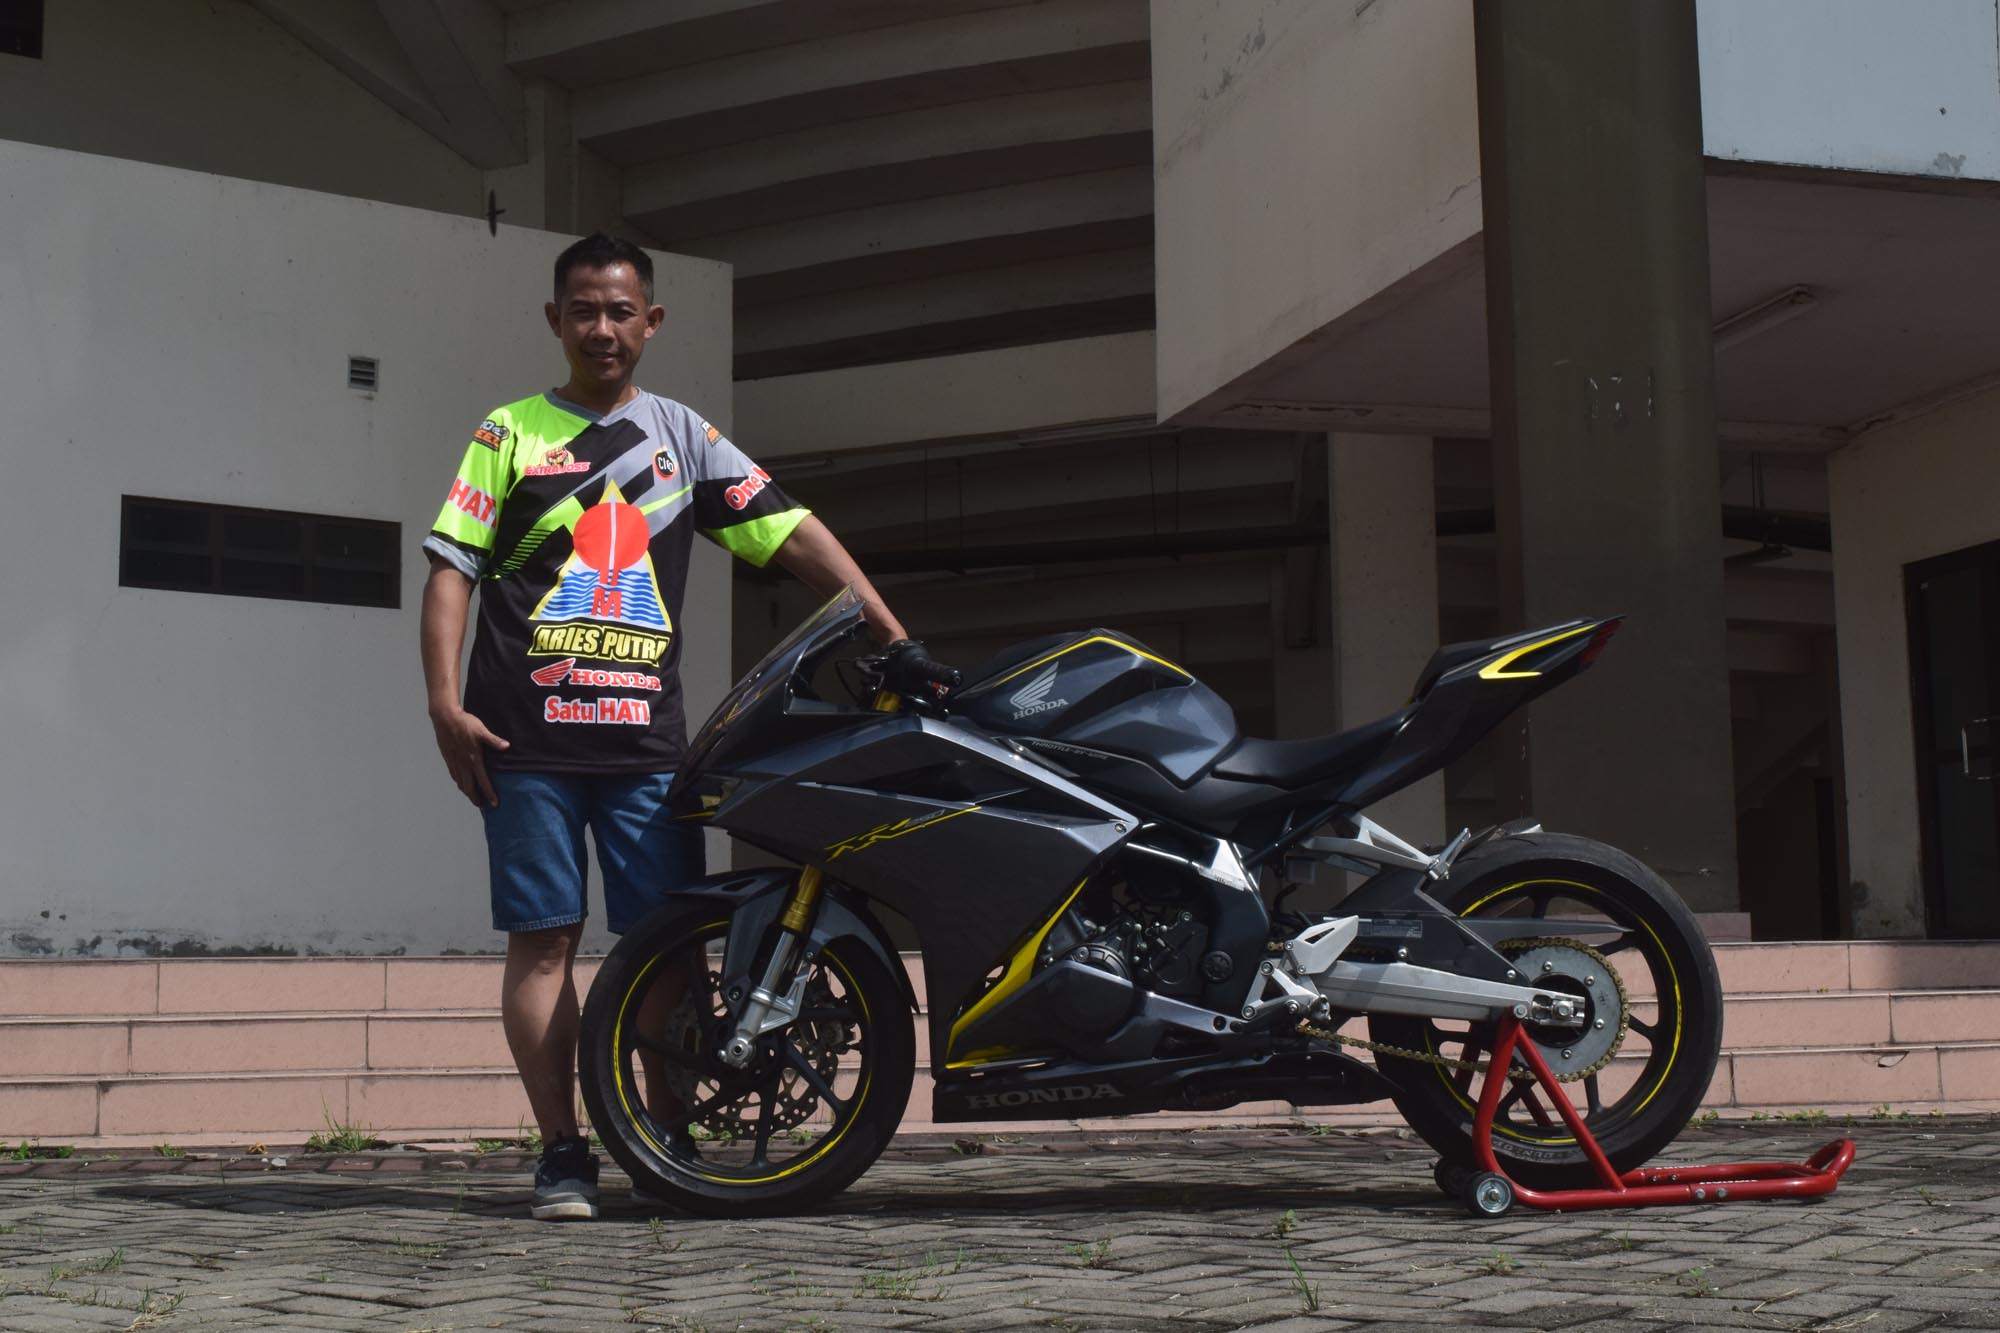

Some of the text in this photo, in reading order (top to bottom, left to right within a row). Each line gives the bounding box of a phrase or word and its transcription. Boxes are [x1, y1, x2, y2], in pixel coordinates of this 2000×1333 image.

[535, 626, 600, 654] ARIES
[569, 668, 662, 691] HONDA
[545, 696, 651, 725] Satu HATI
[1013, 698, 1070, 720] HONDA
[964, 1083, 1125, 1110] HONDA
